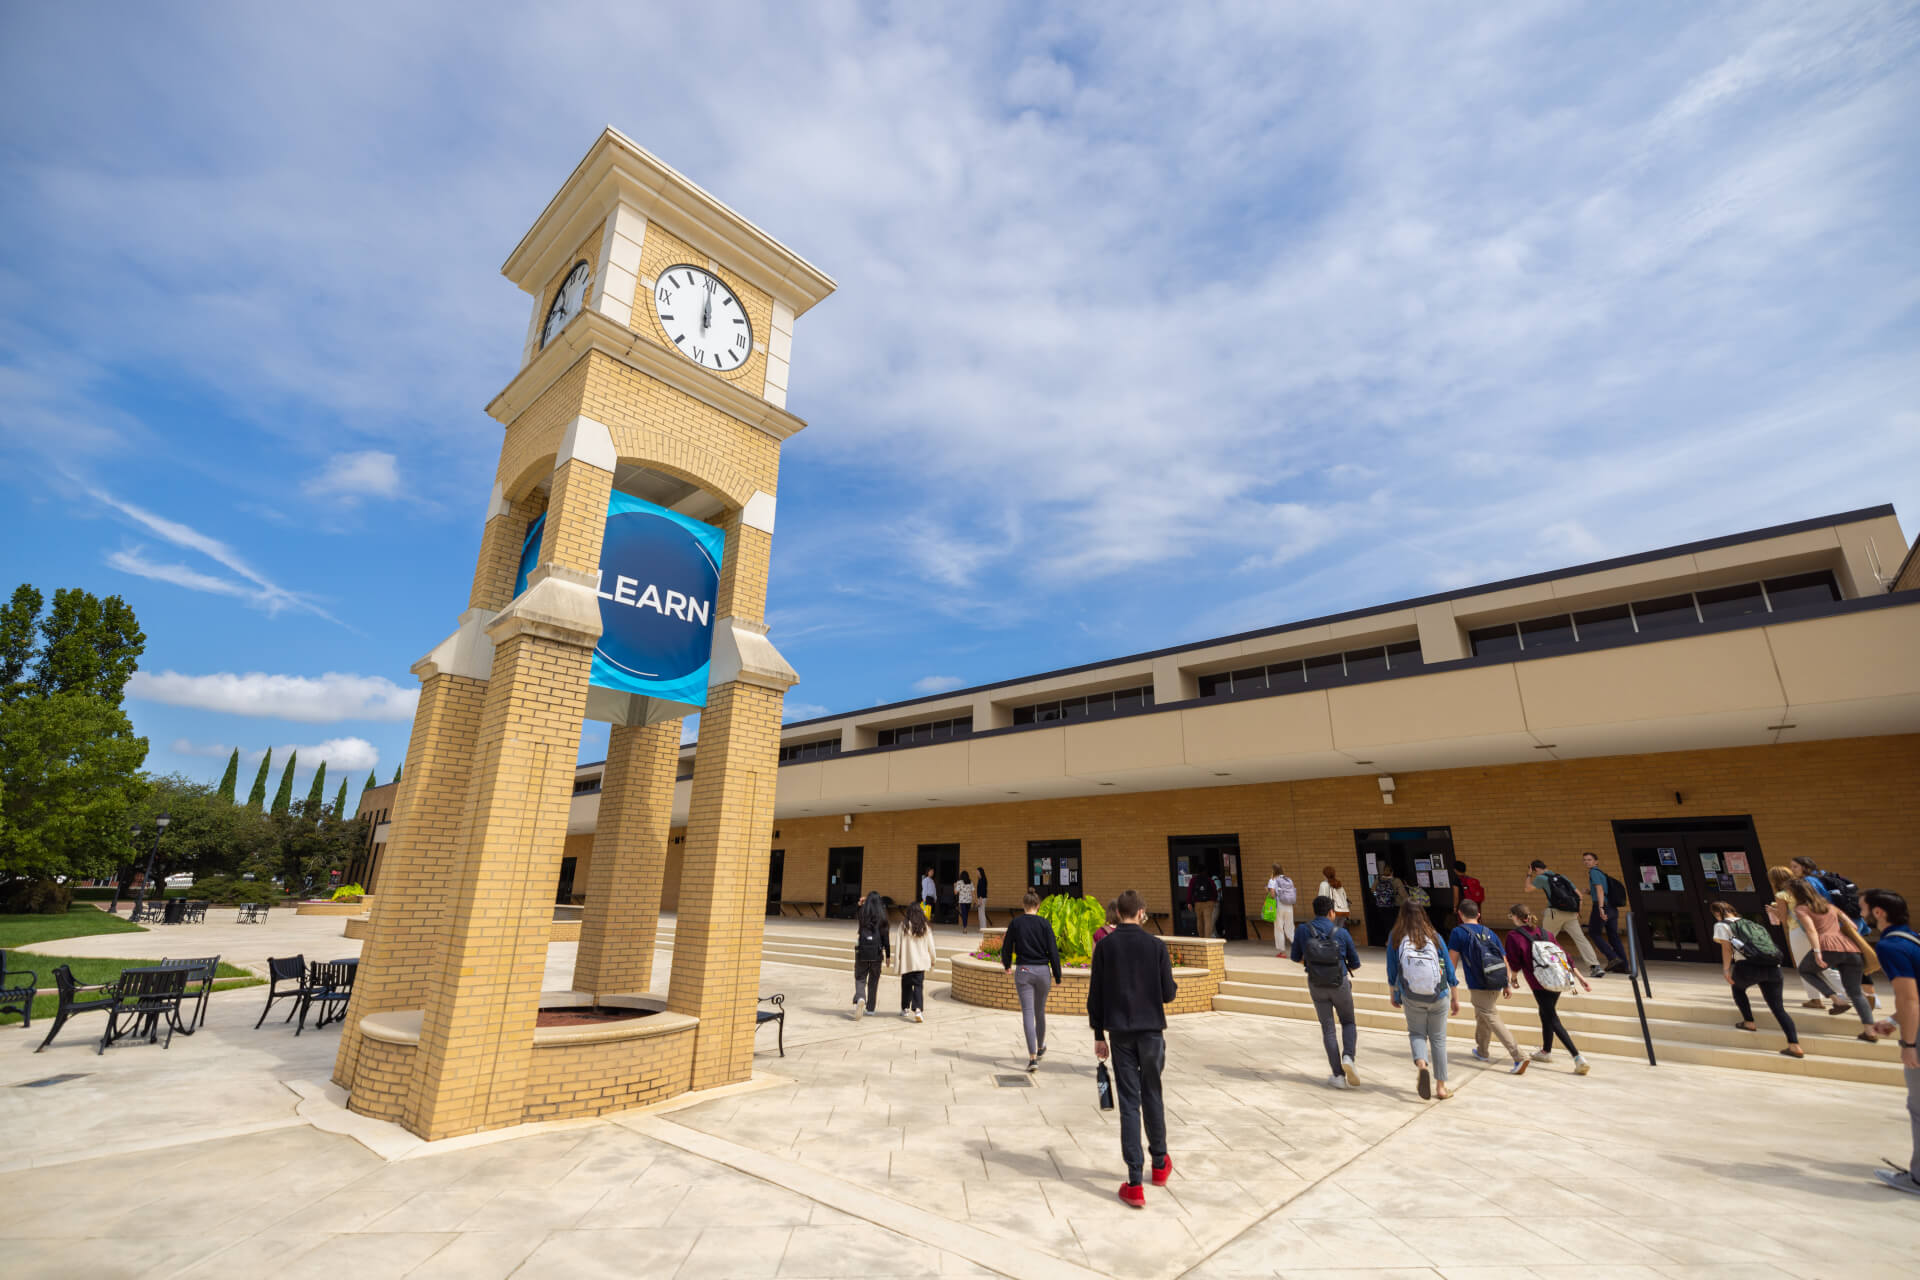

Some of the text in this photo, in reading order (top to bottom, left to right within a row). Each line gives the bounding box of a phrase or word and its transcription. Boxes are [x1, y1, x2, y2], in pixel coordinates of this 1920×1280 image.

[703, 276, 717, 295] XII
[658, 287, 672, 306] IX
[736, 333, 746, 349] III
[693, 345, 704, 363] VI
[596, 569, 710, 627] LEARN
